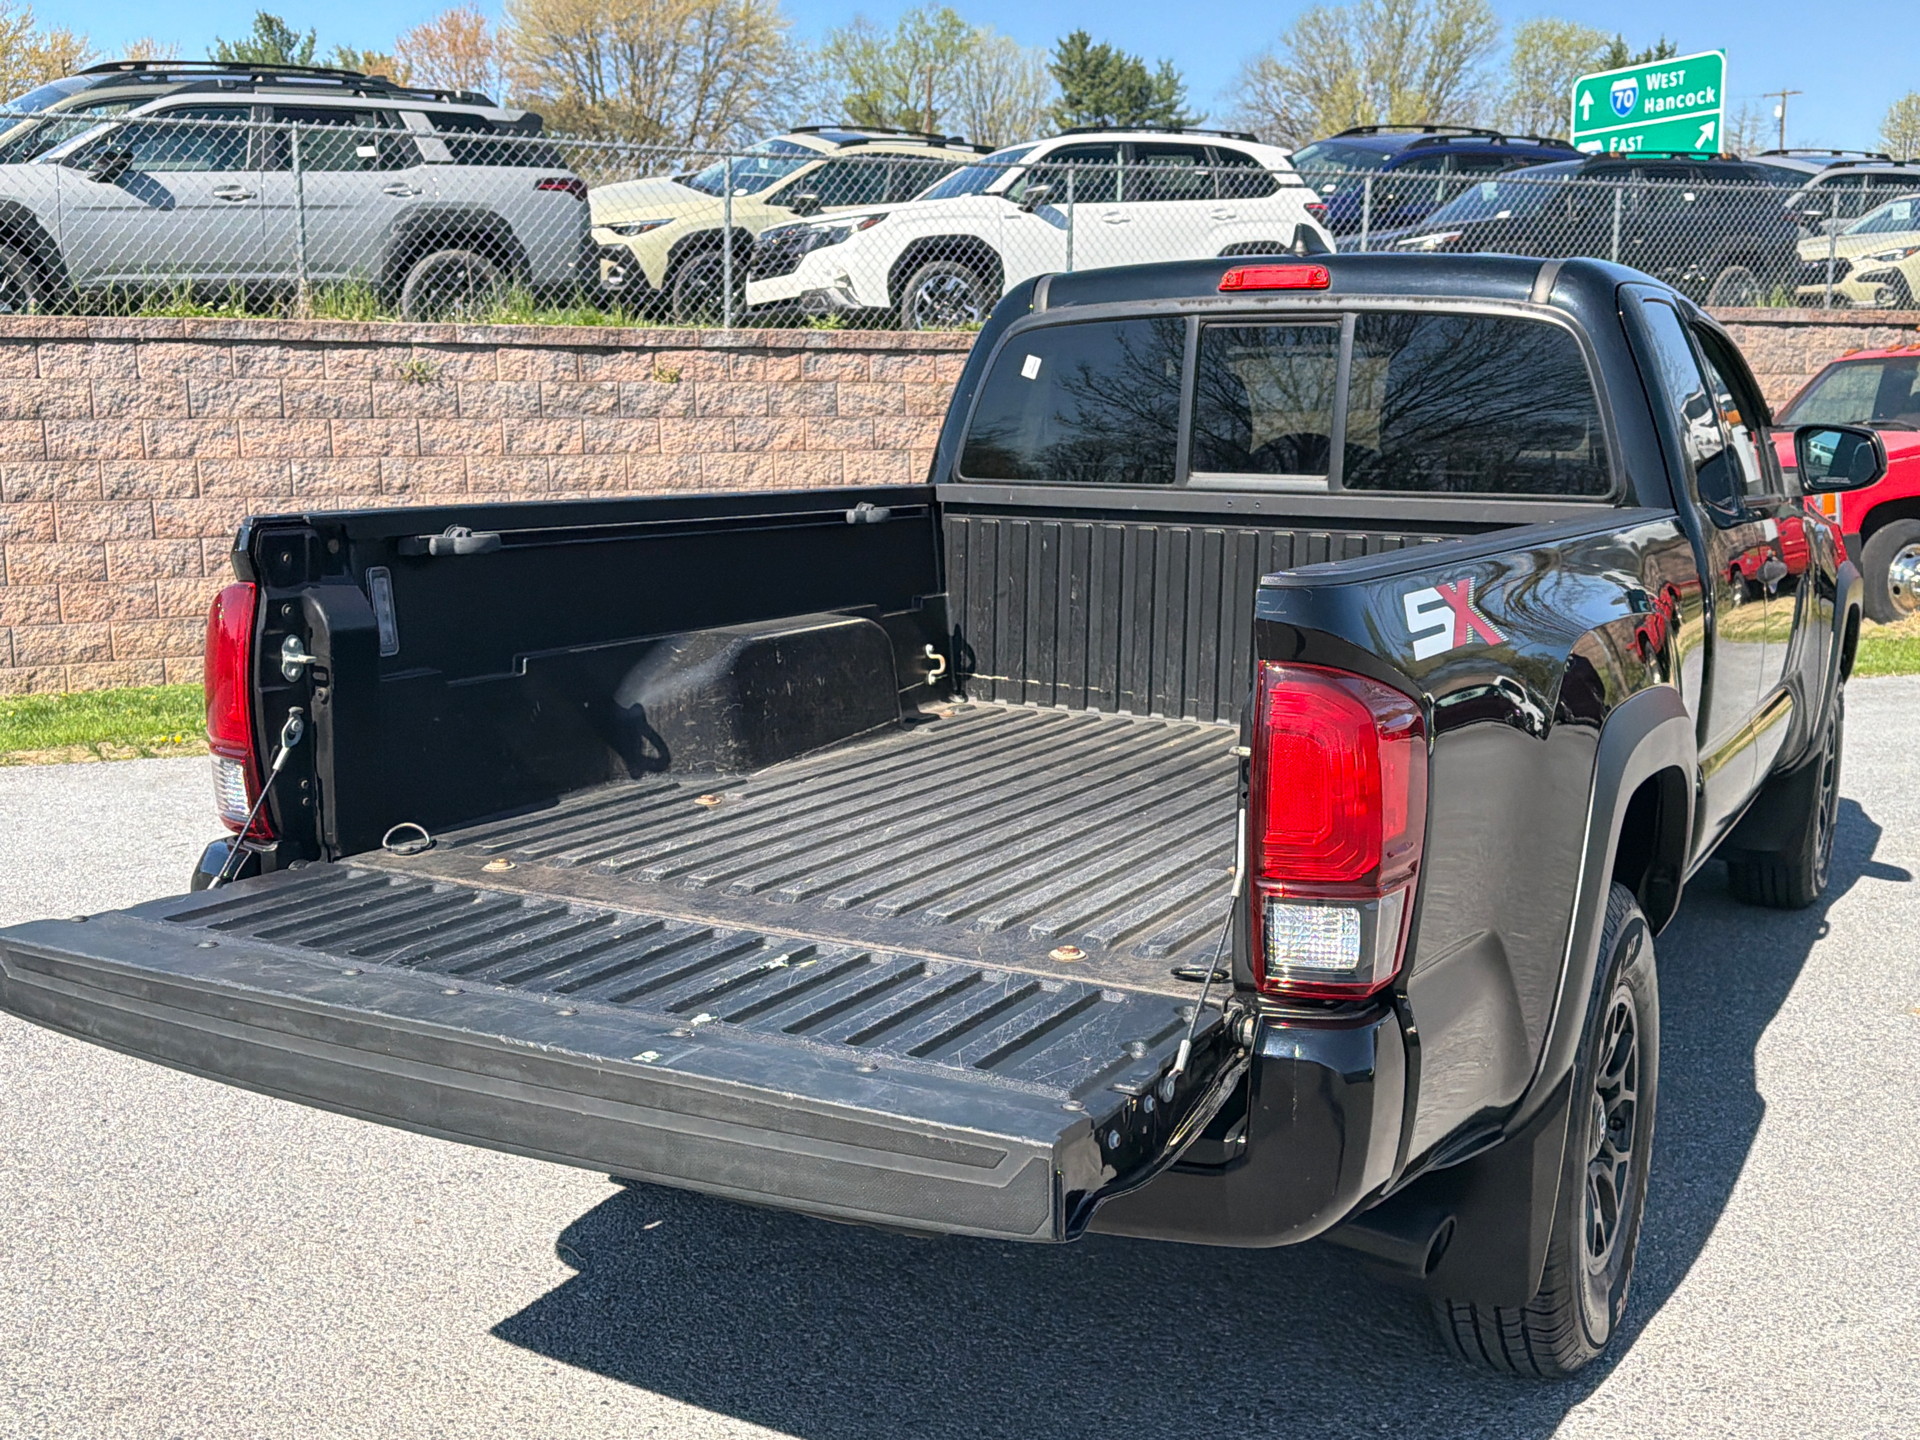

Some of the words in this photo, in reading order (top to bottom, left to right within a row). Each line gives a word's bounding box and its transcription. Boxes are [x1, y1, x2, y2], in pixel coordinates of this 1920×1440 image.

[1645, 70, 1686, 91] WEST
[1614, 89, 1635, 110] 70
[1644, 86, 1716, 114] Hancock
[1610, 135, 1644, 153] EAST
[1403, 576, 1510, 662] SX
